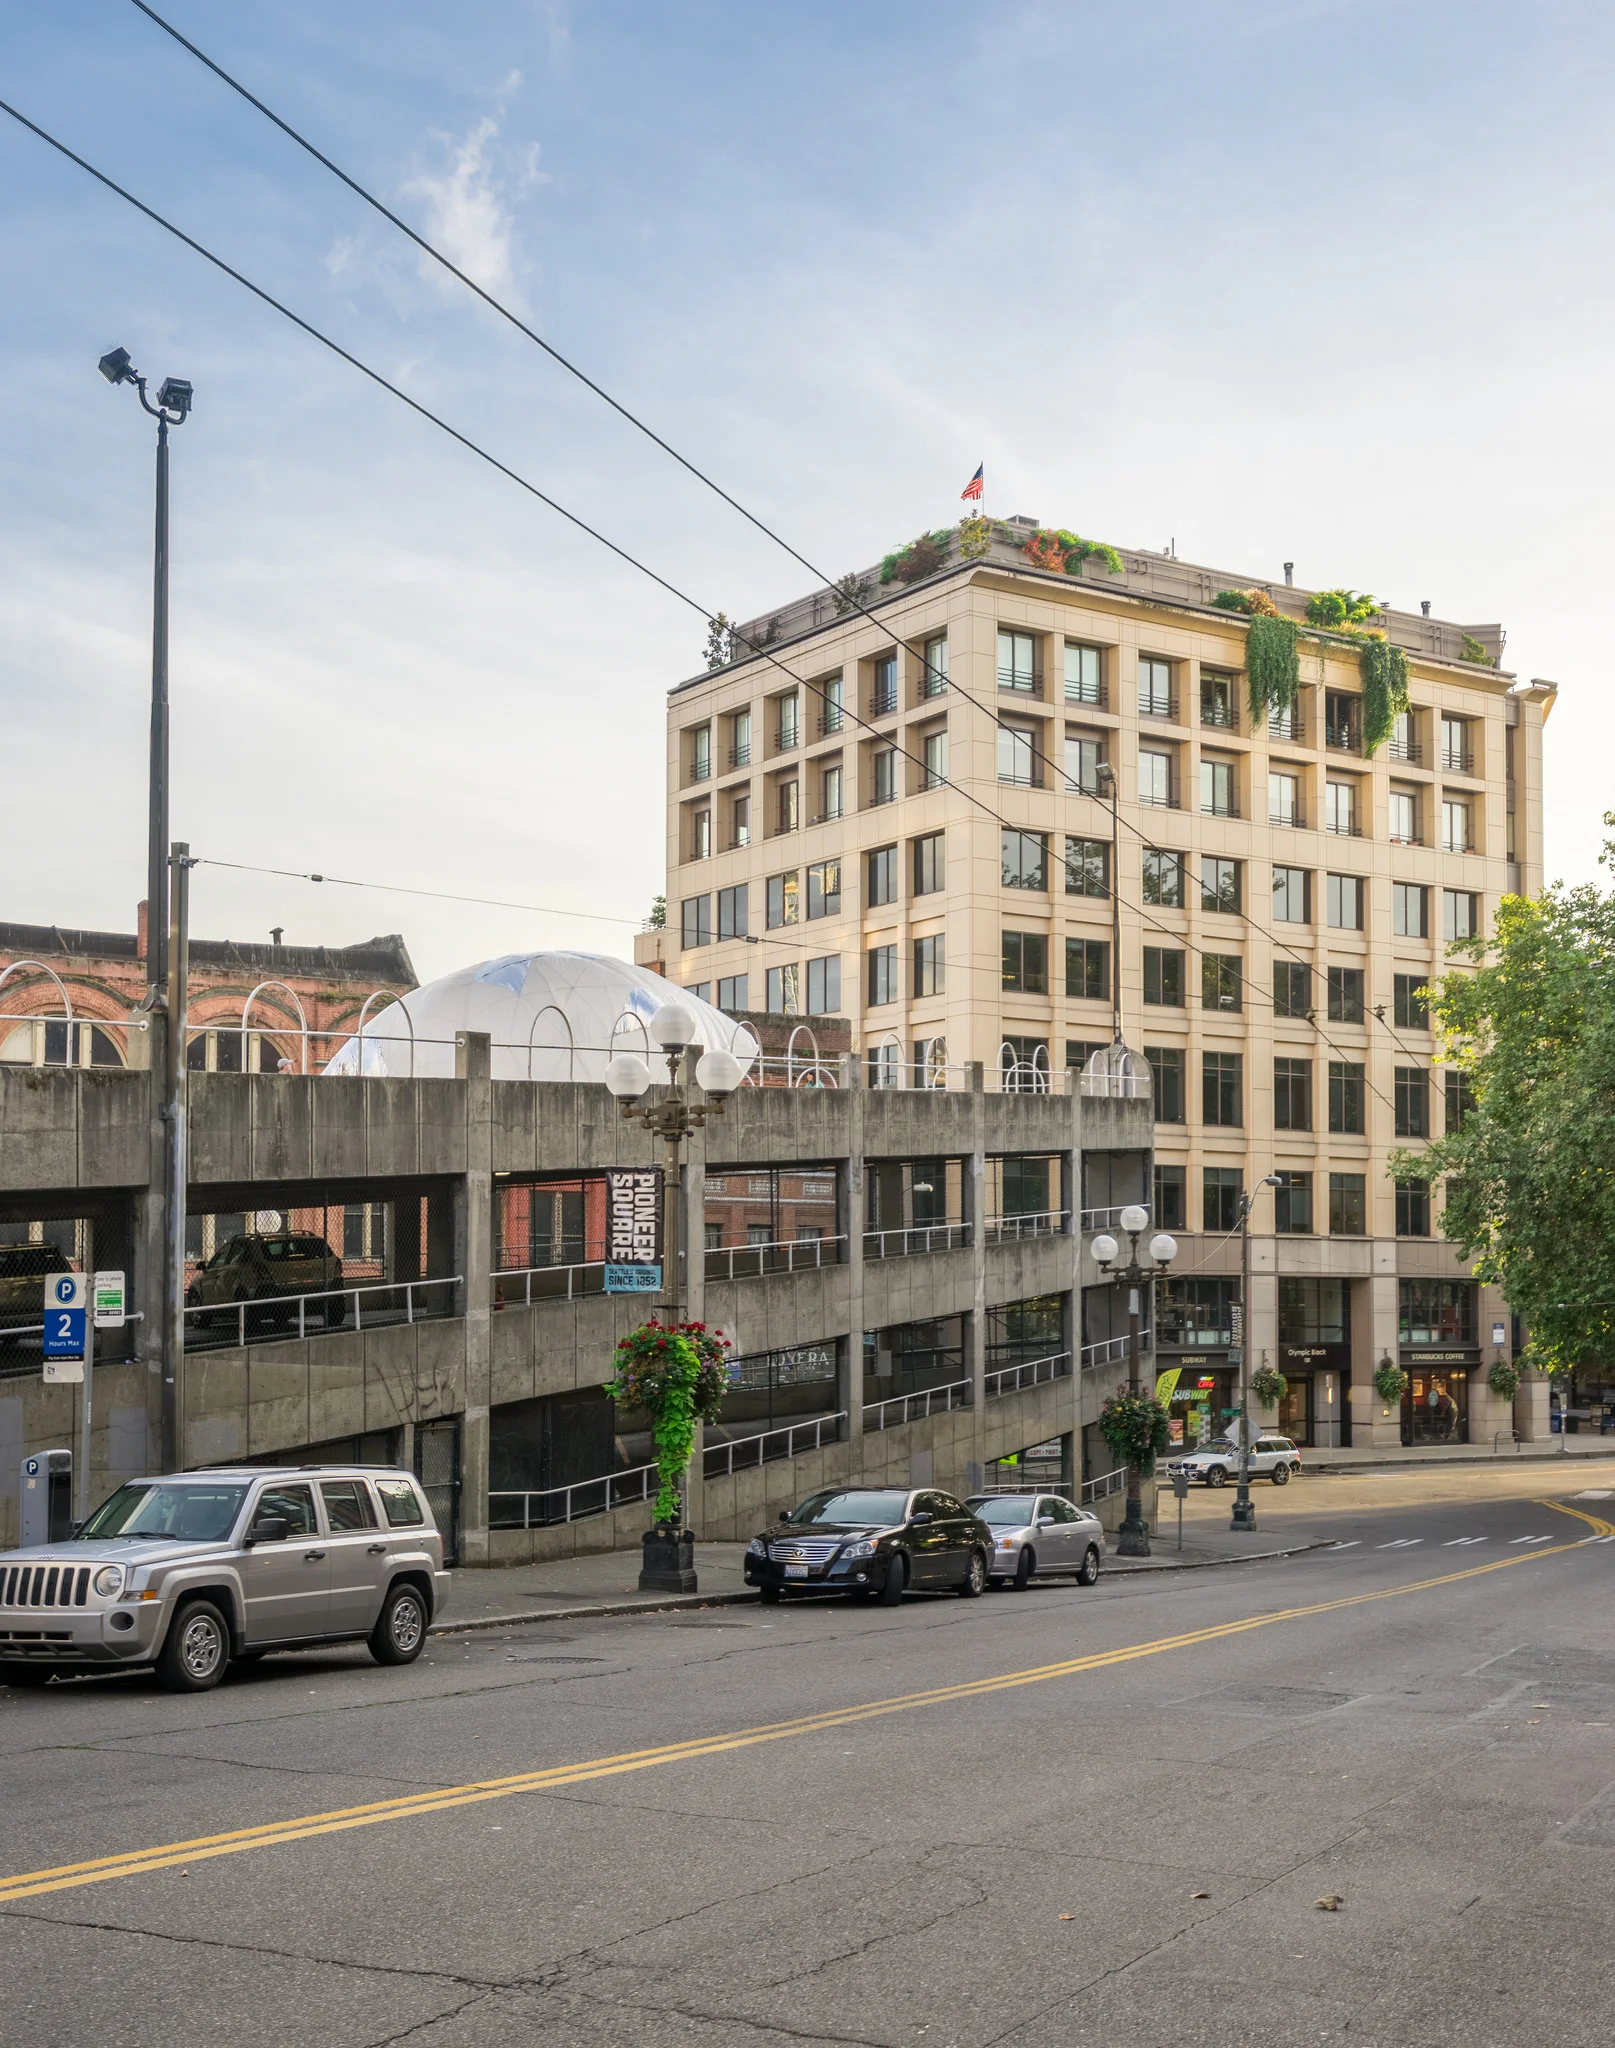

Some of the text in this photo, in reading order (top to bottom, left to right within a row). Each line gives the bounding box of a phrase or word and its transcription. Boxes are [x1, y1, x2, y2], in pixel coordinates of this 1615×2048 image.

[612, 1174, 634, 1260] SQUARE
[634, 1174, 656, 1260] PIONEER
[608, 1275, 656, 1286] SINCE 1852
[61, 1283, 72, 1298] P
[58, 1314, 71, 1337] 2
[1288, 1349, 1310, 1357] Olympic
[1181, 1356, 1207, 1364] SUBWAY
[1172, 1389, 1210, 1400] SUBWAY
[29, 1462, 37, 1473] P
